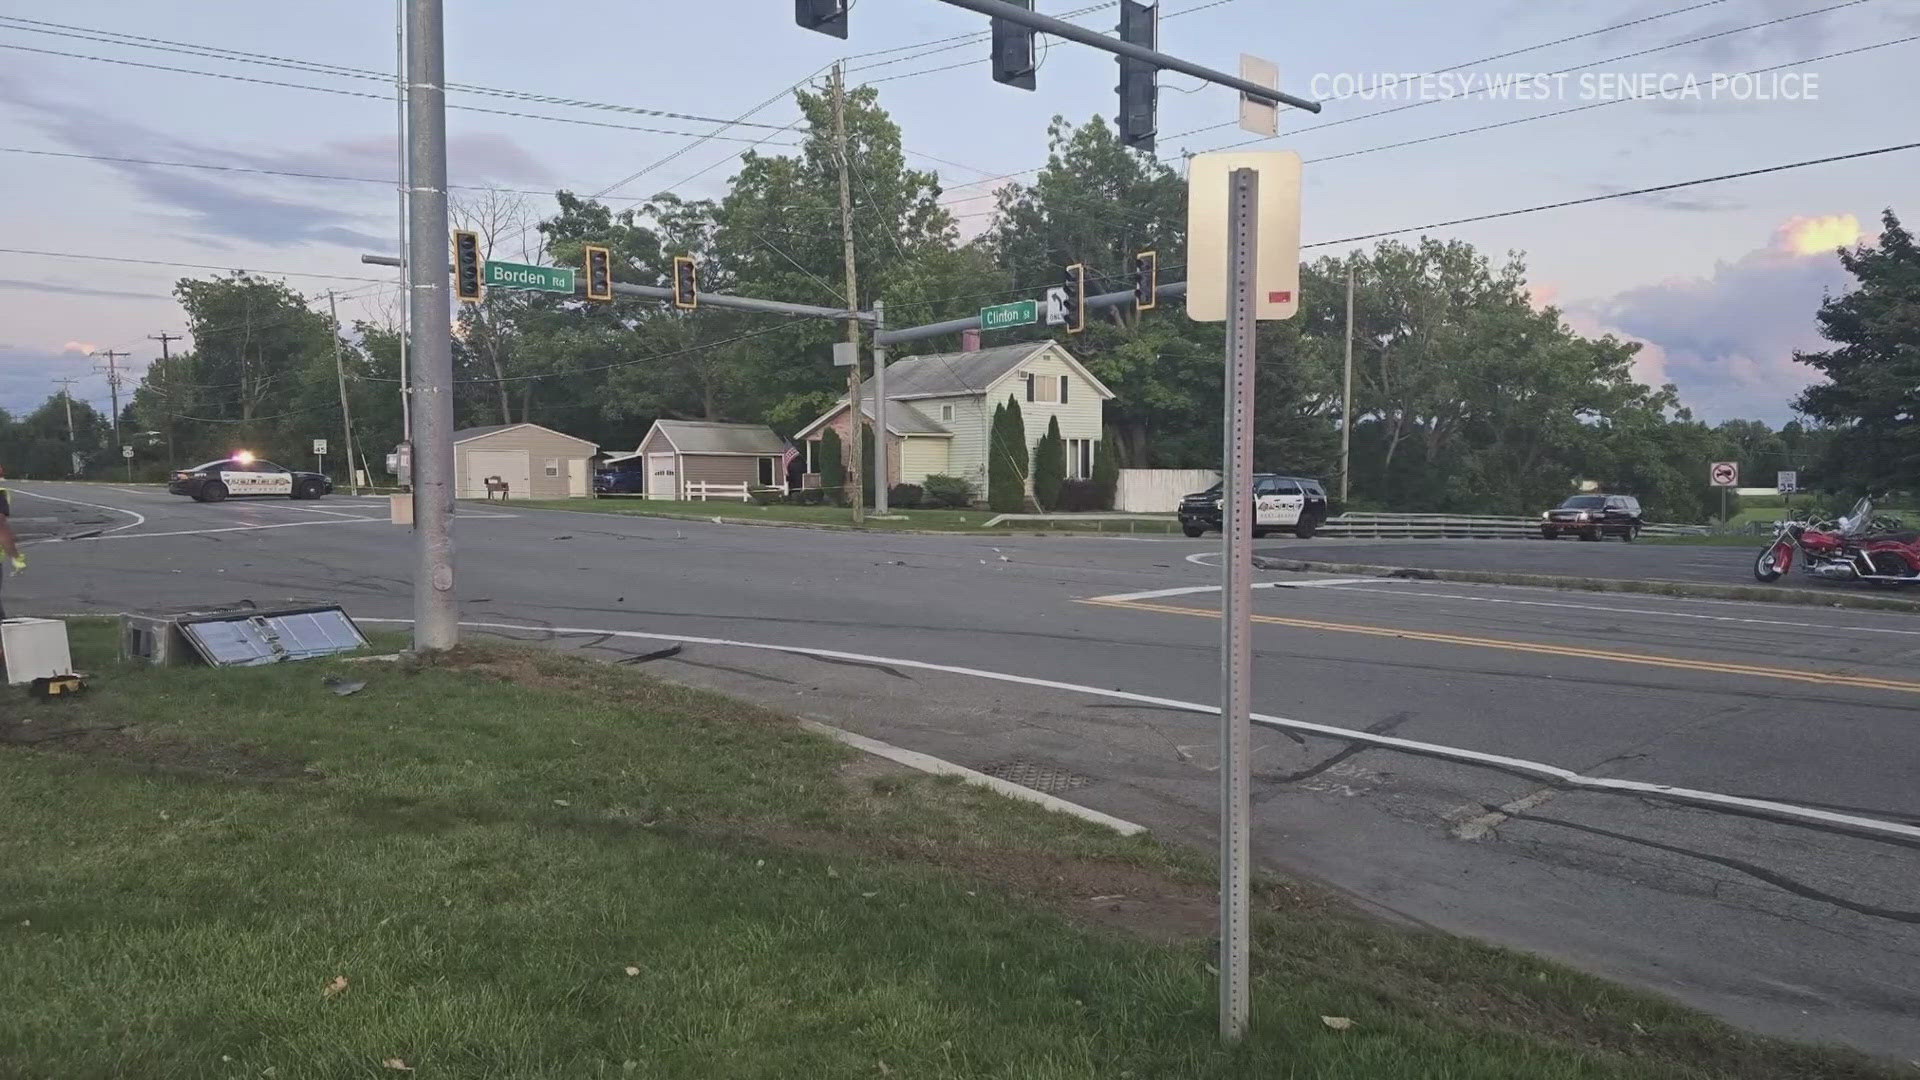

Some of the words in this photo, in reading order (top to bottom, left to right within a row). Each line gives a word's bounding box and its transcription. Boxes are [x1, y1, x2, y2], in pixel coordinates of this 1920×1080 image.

[494, 267, 545, 285] Borden
[552, 277, 565, 287] Rd
[987, 310, 1019, 325] Clinton
[1780, 483, 1794, 492] 35
